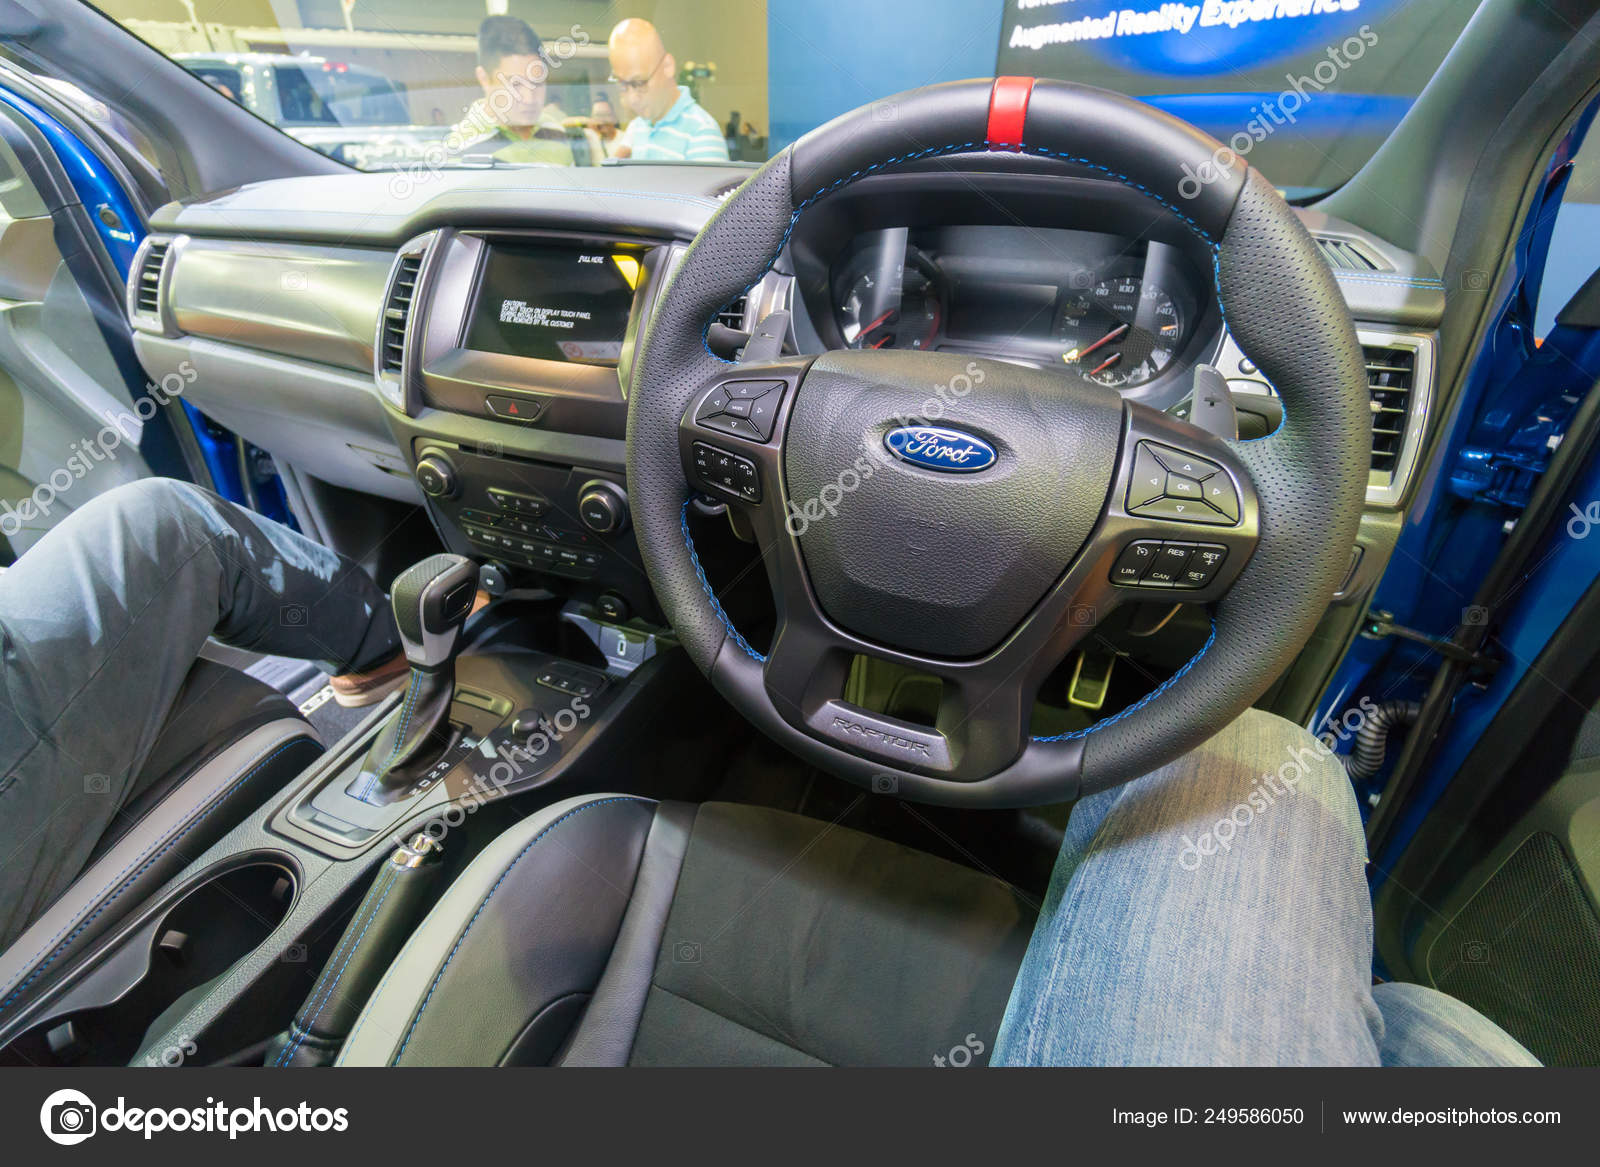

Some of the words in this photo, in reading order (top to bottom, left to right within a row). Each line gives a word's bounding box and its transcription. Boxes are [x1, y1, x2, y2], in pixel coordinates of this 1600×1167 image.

[1009, 11, 1117, 50] Augmented
[1116, 3, 1200, 36] Reality
[1119, 284, 1135, 294] 100
[906, 430, 981, 464] Ford
[1177, 482, 1190, 491] OK
[1167, 548, 1185, 557] RES
[1203, 552, 1220, 560] SET
[1121, 567, 1136, 575] LIM
[1188, 571, 1206, 580] SET
[1152, 572, 1170, 581] CAN
[833, 716, 931, 759] RAPTOR
